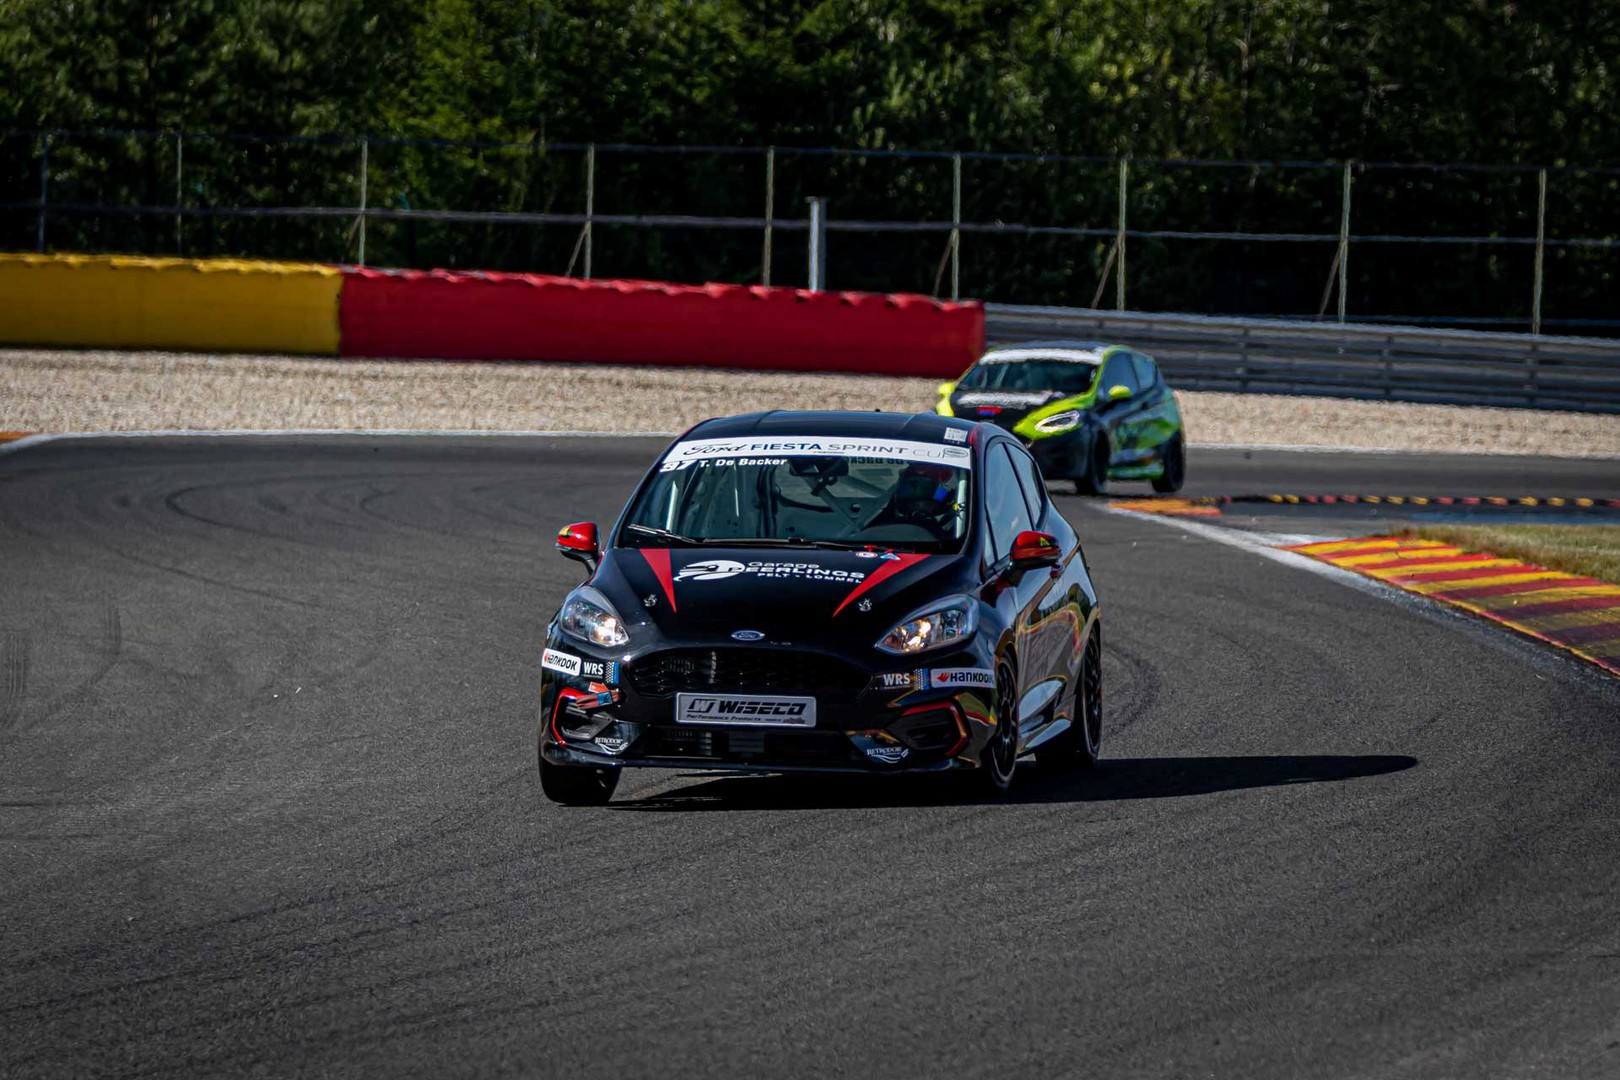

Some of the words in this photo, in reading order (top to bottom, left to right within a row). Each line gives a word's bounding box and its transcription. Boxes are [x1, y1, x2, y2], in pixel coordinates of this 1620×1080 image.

[683, 443, 747, 456] Ford
[750, 442, 822, 451] FIESTA
[828, 443, 908, 454] SPRINT
[700, 459, 710, 468] T.
[716, 459, 735, 467] De
[738, 458, 787, 467] Backer
[806, 574, 862, 583] LOMMEL
[583, 661, 604, 675] WRS
[883, 673, 911, 686] WRS
[718, 700, 807, 715] WISECO
